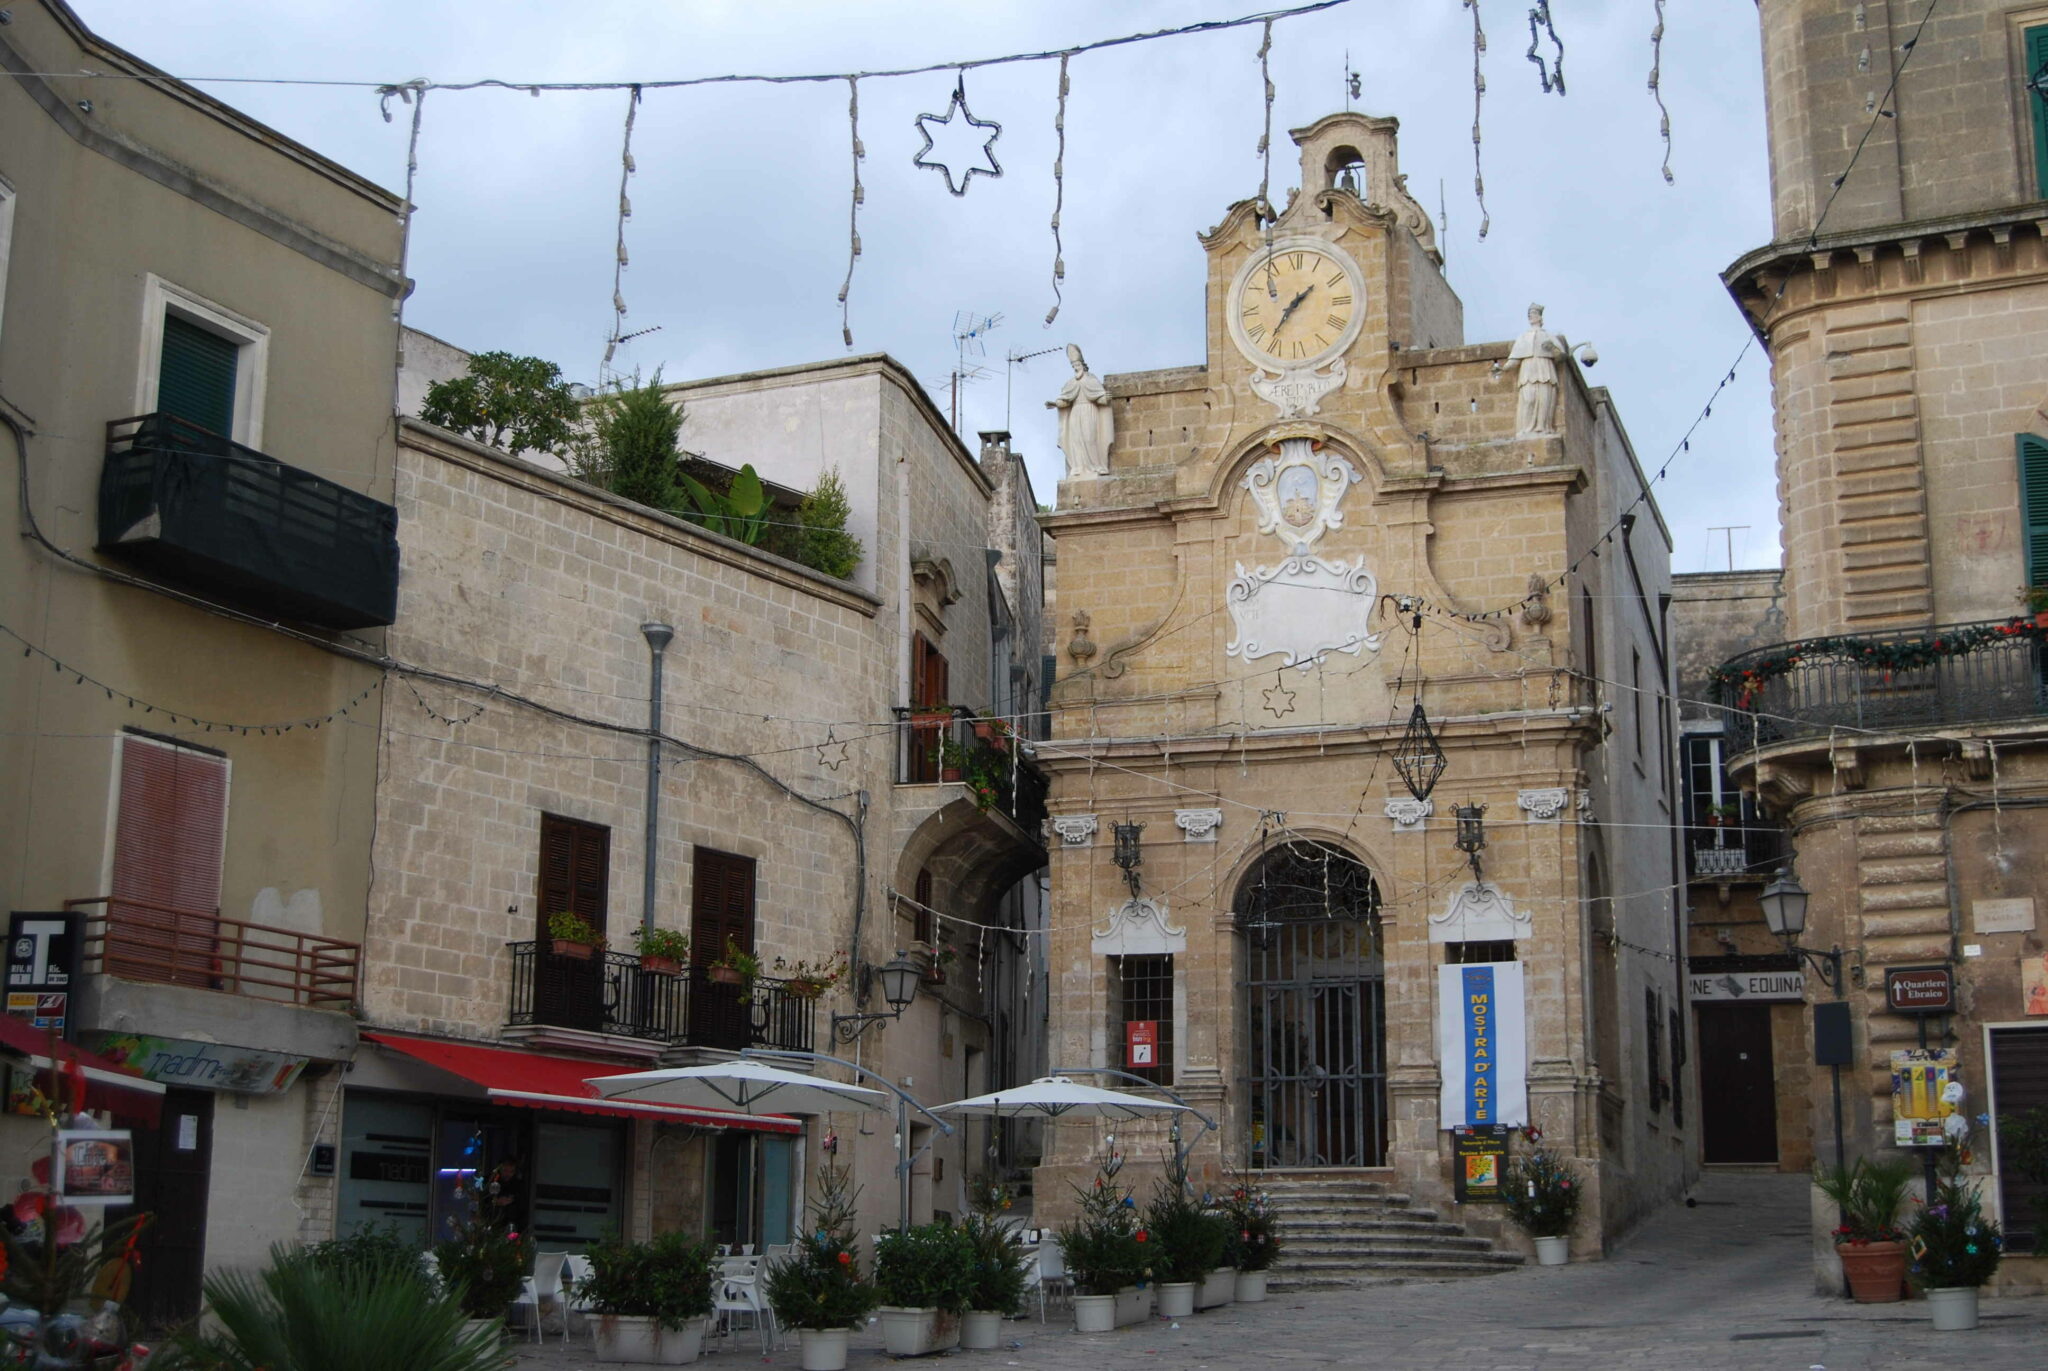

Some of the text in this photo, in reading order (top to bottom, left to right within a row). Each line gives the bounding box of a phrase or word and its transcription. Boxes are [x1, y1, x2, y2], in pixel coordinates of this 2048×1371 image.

[22, 920, 65, 985] T
[1690, 978, 1712, 995] NE
[1903, 979, 1946, 989] Quartiere
[1908, 990, 1943, 999] Ebraico
[1471, 994, 1488, 1058] MOSTRA
